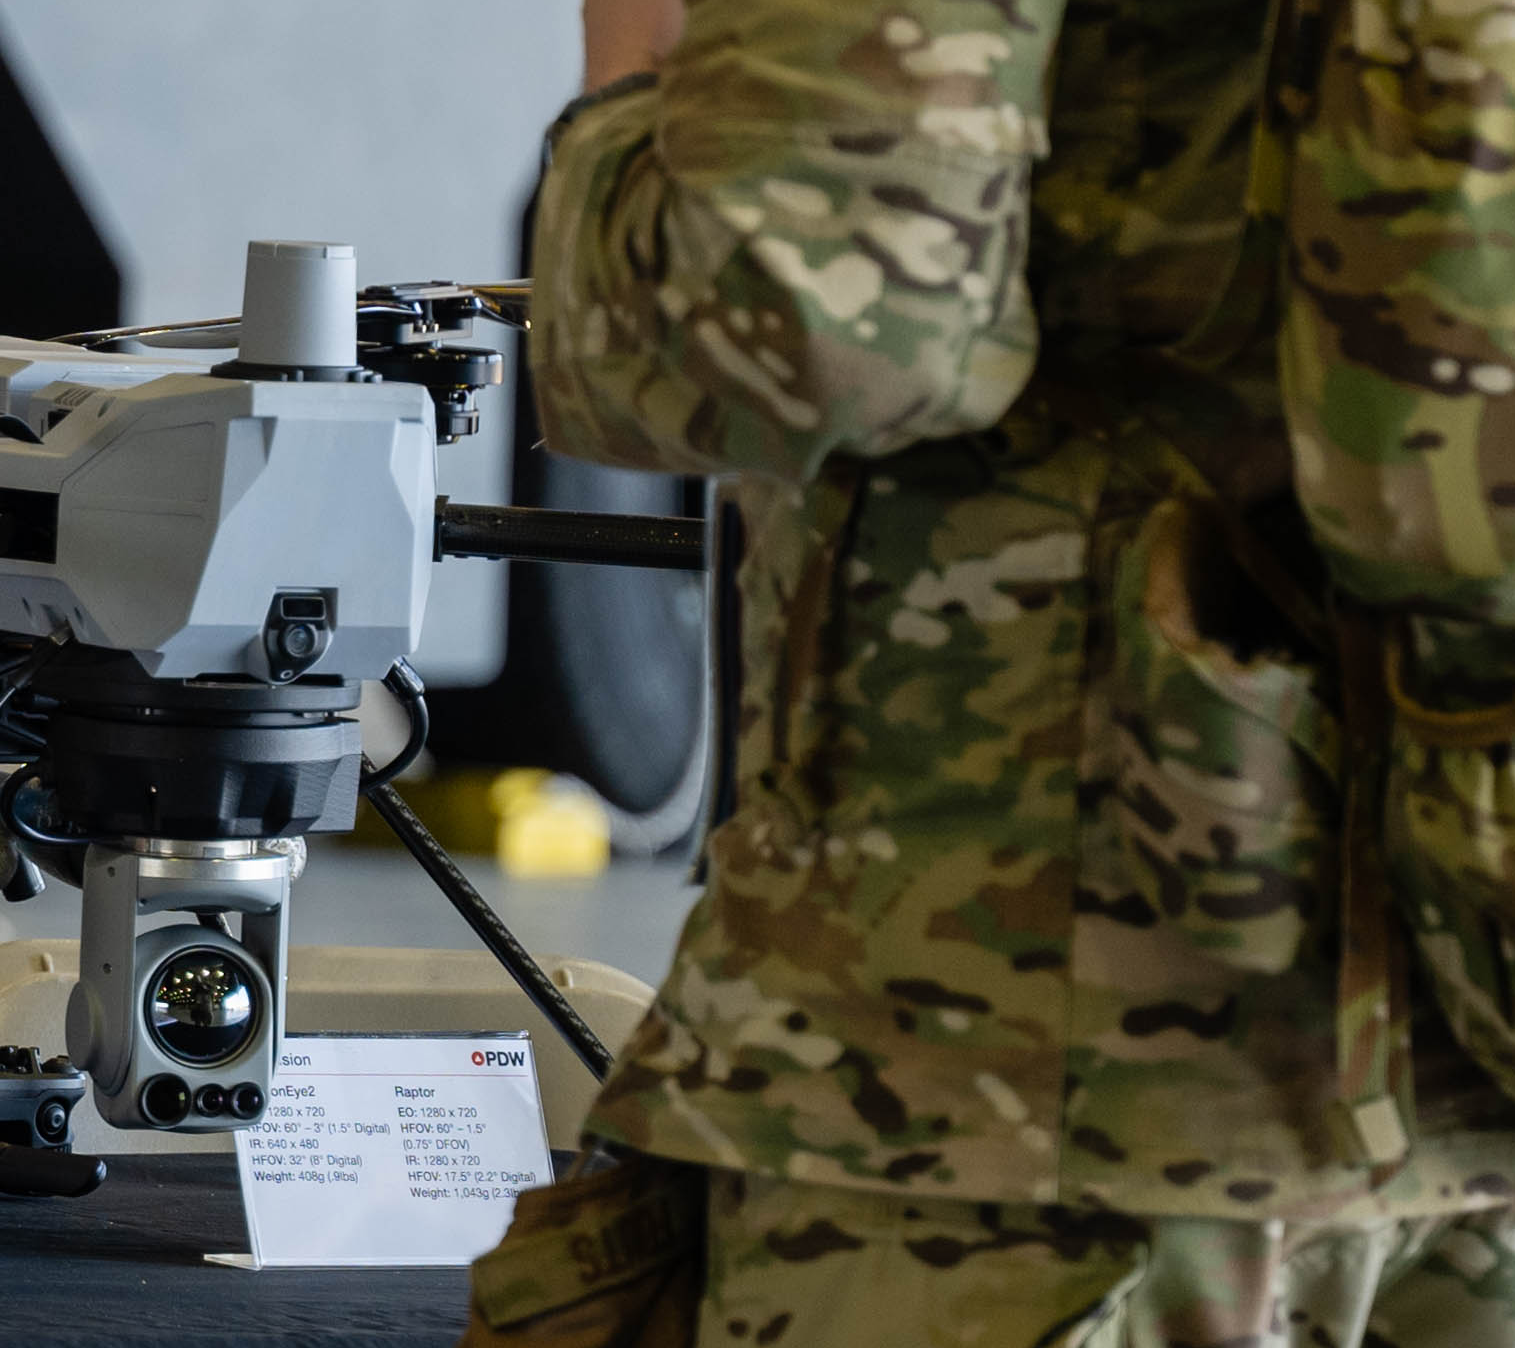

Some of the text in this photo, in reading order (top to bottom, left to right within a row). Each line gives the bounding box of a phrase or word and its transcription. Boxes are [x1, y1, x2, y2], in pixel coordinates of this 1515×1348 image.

[279, 1051, 525, 1067] sion PDW
[271, 1085, 435, 1100] onEye2 Raptor
[267, 1106, 326, 1118] 1280 x 720
[397, 1106, 478, 1118] EO: 1280 x 720
[354, 1123, 391, 1137] Digital)
[400, 1123, 435, 1134] HFOV:
[249, 1138, 265, 1149] IR:
[267, 1138, 288, 1149] 640
[299, 1138, 319, 1149] 480
[435, 1139, 470, 1152] DFOV)
[252, 1155, 287, 1166] HFOV:
[327, 1155, 363, 1169] Digital)
[405, 1155, 481, 1166] IR: 1280 x 720
[254, 1171, 359, 1184] Weight: 408g (.9lbs)
[407, 1171, 442, 1182] HFOV:
[500, 1171, 537, 1184] Digital)
[409, 1187, 521, 1200] Weight: 1,043g (2.3lb
